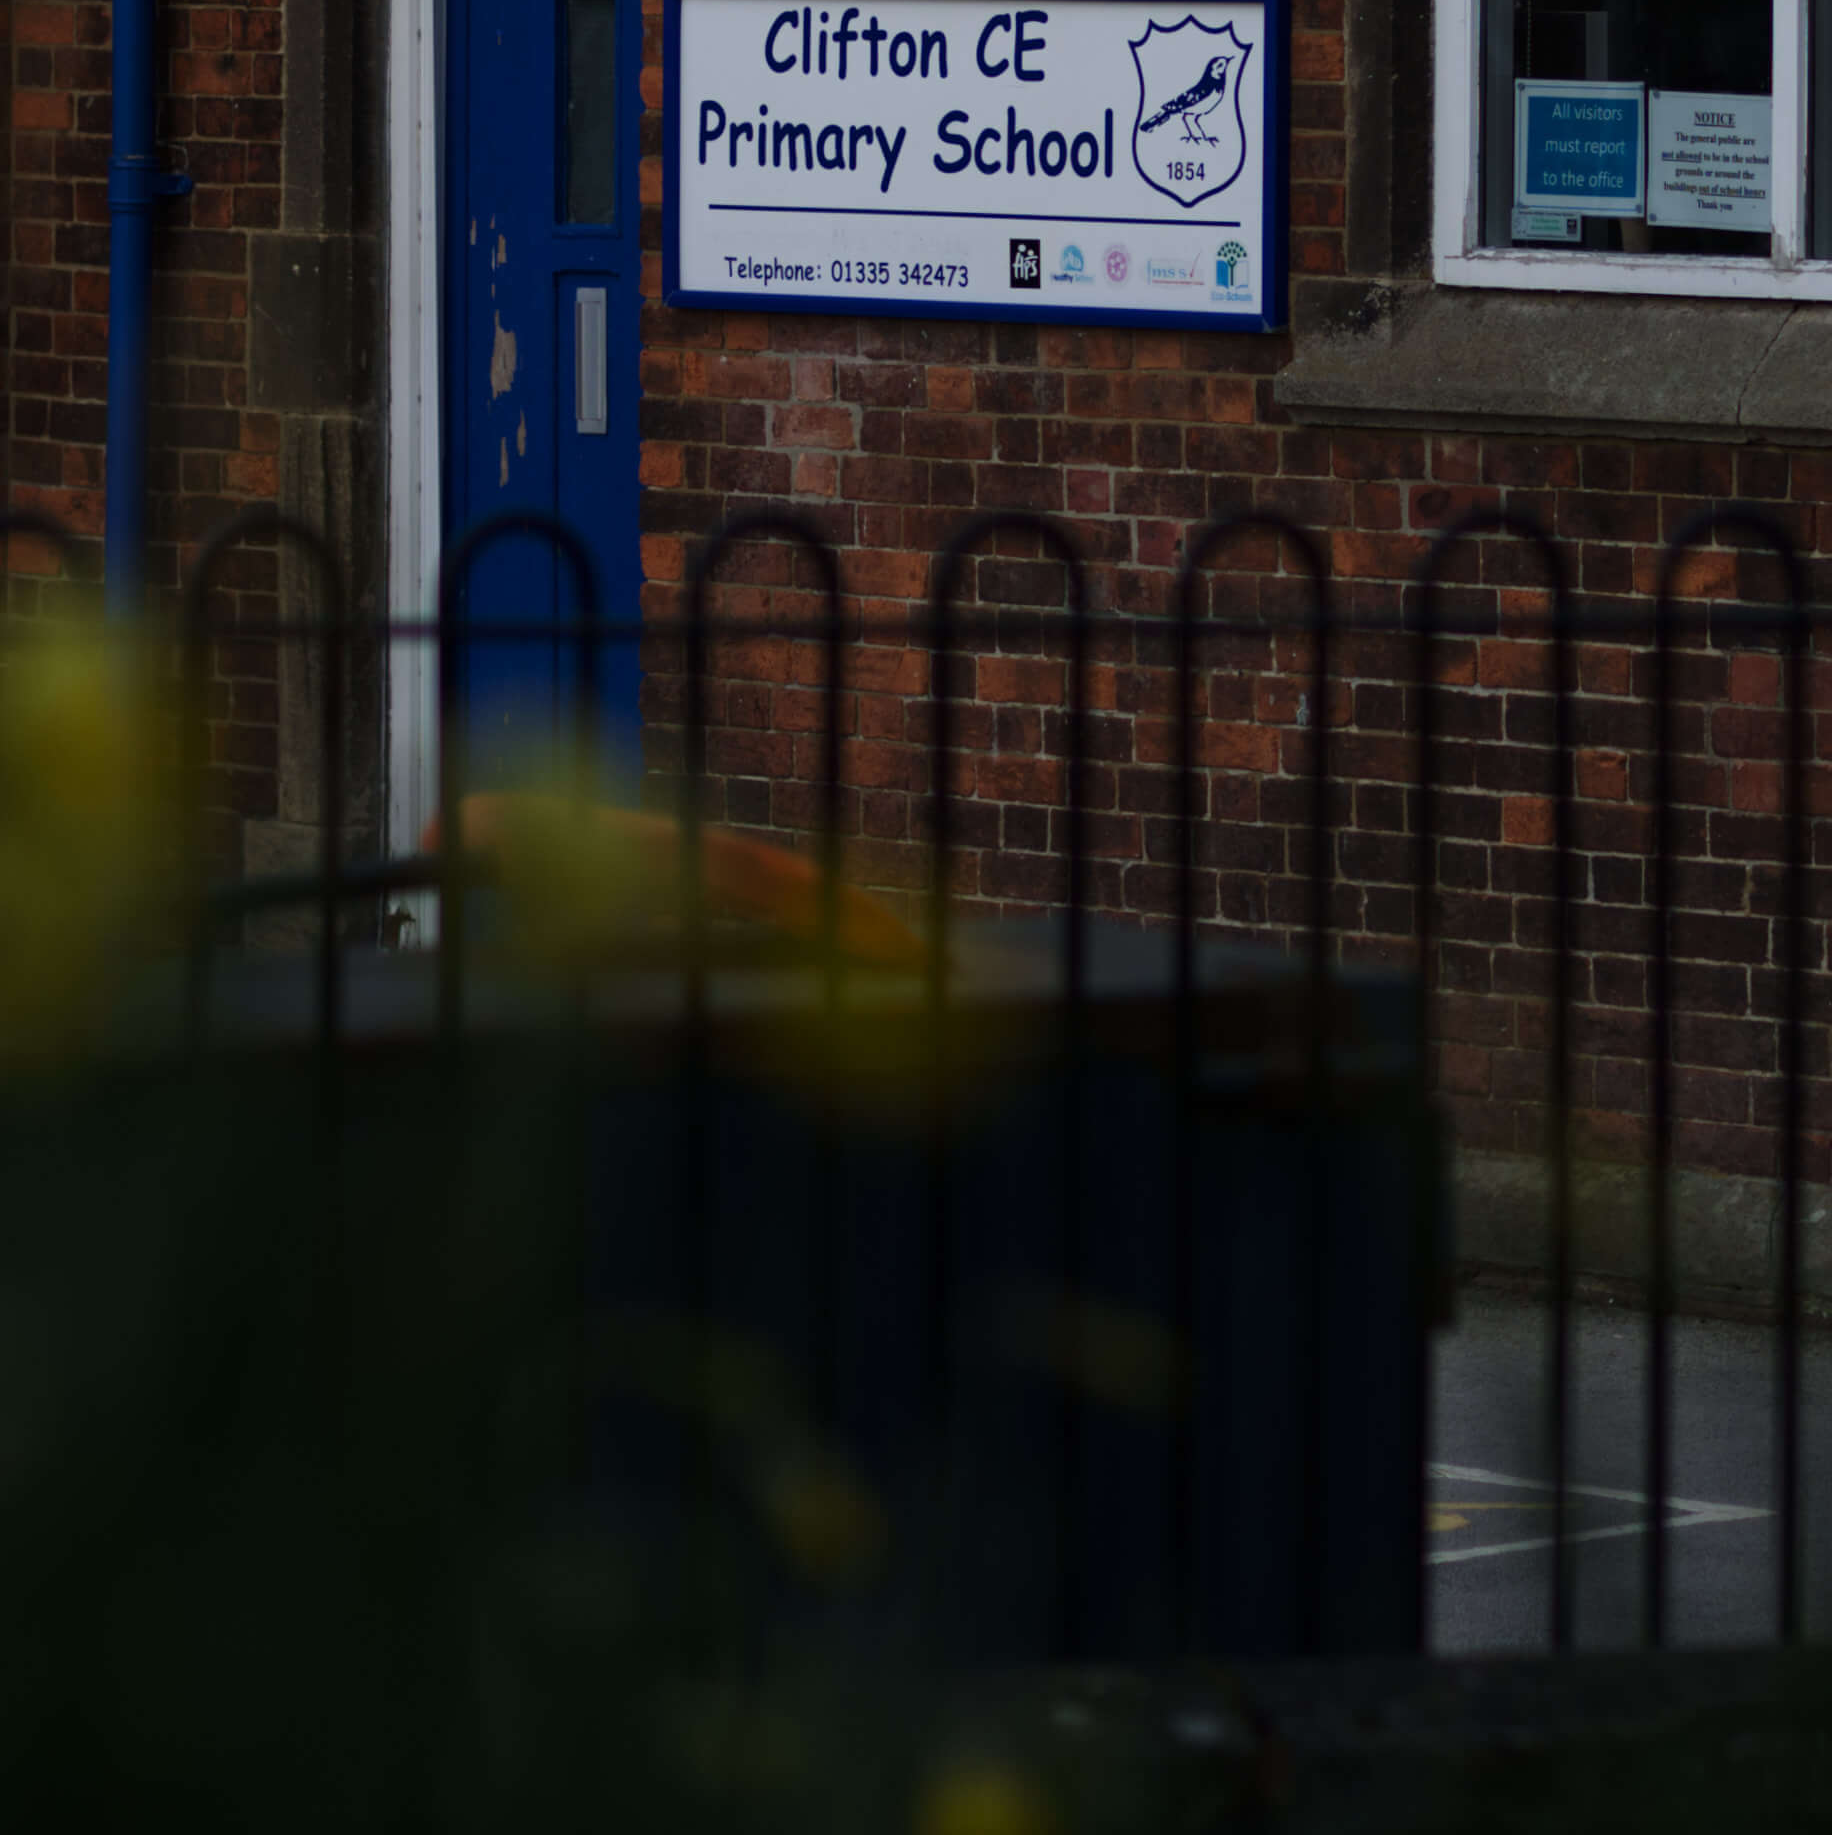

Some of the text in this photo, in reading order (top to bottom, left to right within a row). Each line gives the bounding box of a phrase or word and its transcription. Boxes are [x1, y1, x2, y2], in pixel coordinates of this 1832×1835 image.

[764, 6, 1049, 82] Clifton CE
[1552, 101, 1625, 122] All visitors
[1694, 111, 1736, 127] NOTICE
[698, 99, 1114, 194] Primary School
[1544, 138, 1626, 157] must report
[1166, 161, 1206, 182] 1854
[1542, 168, 1625, 189] to the office
[724, 256, 969, 288] Telephone: 01335 342473
